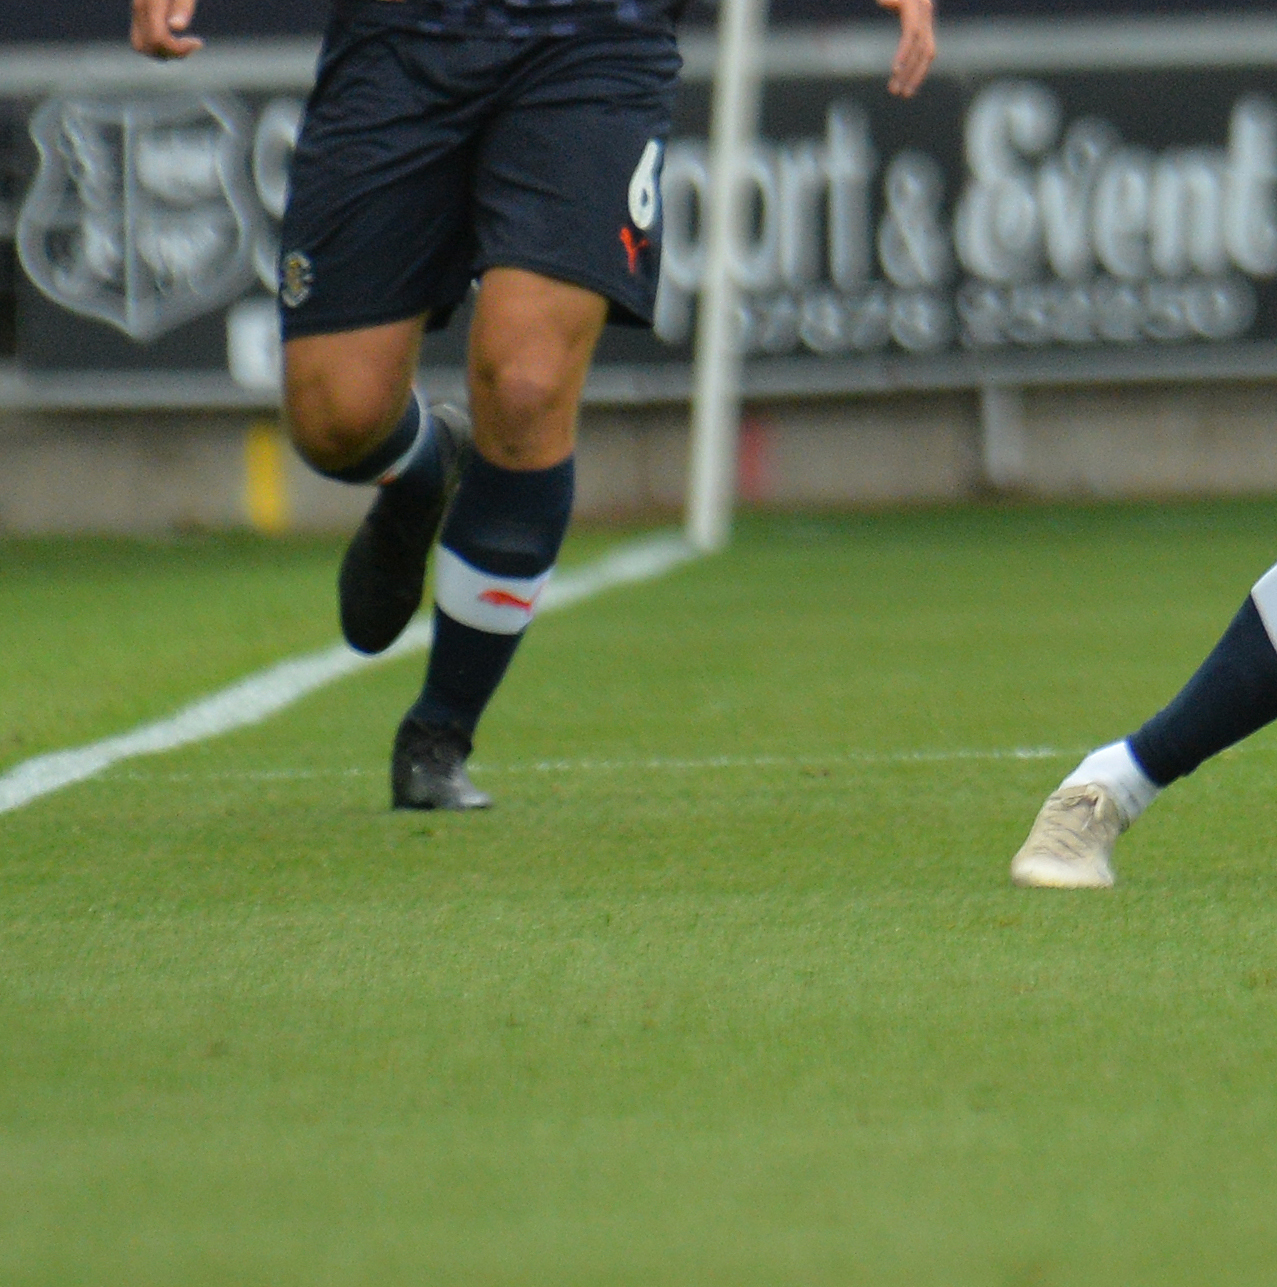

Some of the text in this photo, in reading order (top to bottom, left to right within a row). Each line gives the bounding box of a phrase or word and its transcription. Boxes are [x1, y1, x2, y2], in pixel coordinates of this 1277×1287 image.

[628, 139, 660, 230] 6
[654, 105, 868, 343] port
[880, 153, 948, 287] &
